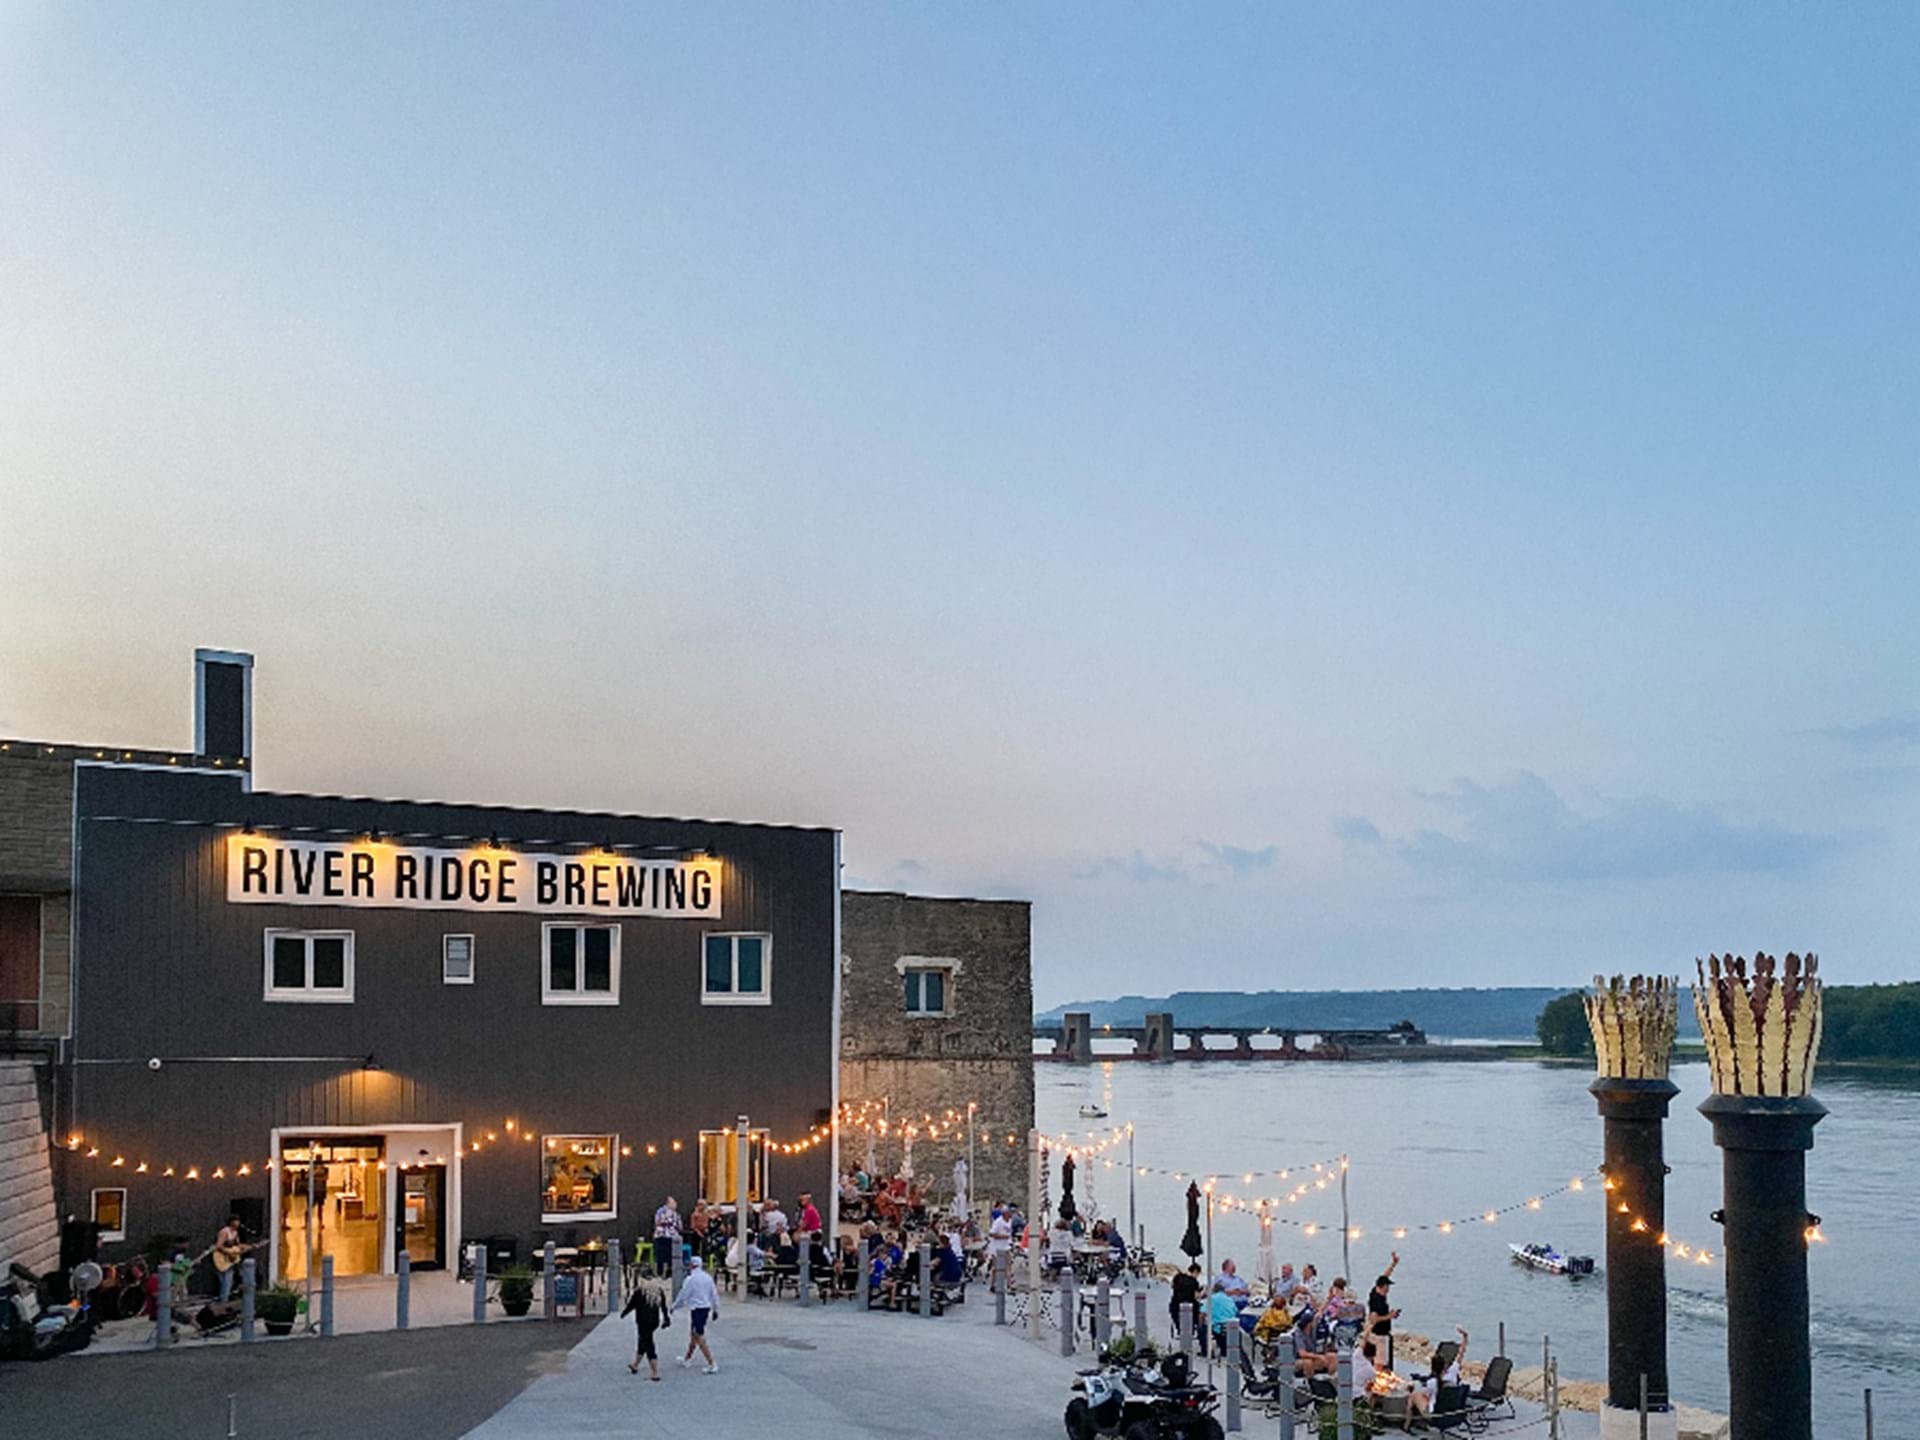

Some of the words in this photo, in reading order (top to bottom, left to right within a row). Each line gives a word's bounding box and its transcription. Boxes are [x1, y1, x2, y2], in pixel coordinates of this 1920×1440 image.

[242, 846, 375, 898] RIVER
[395, 855, 517, 904] RIDGE
[536, 861, 712, 911] BREWING
